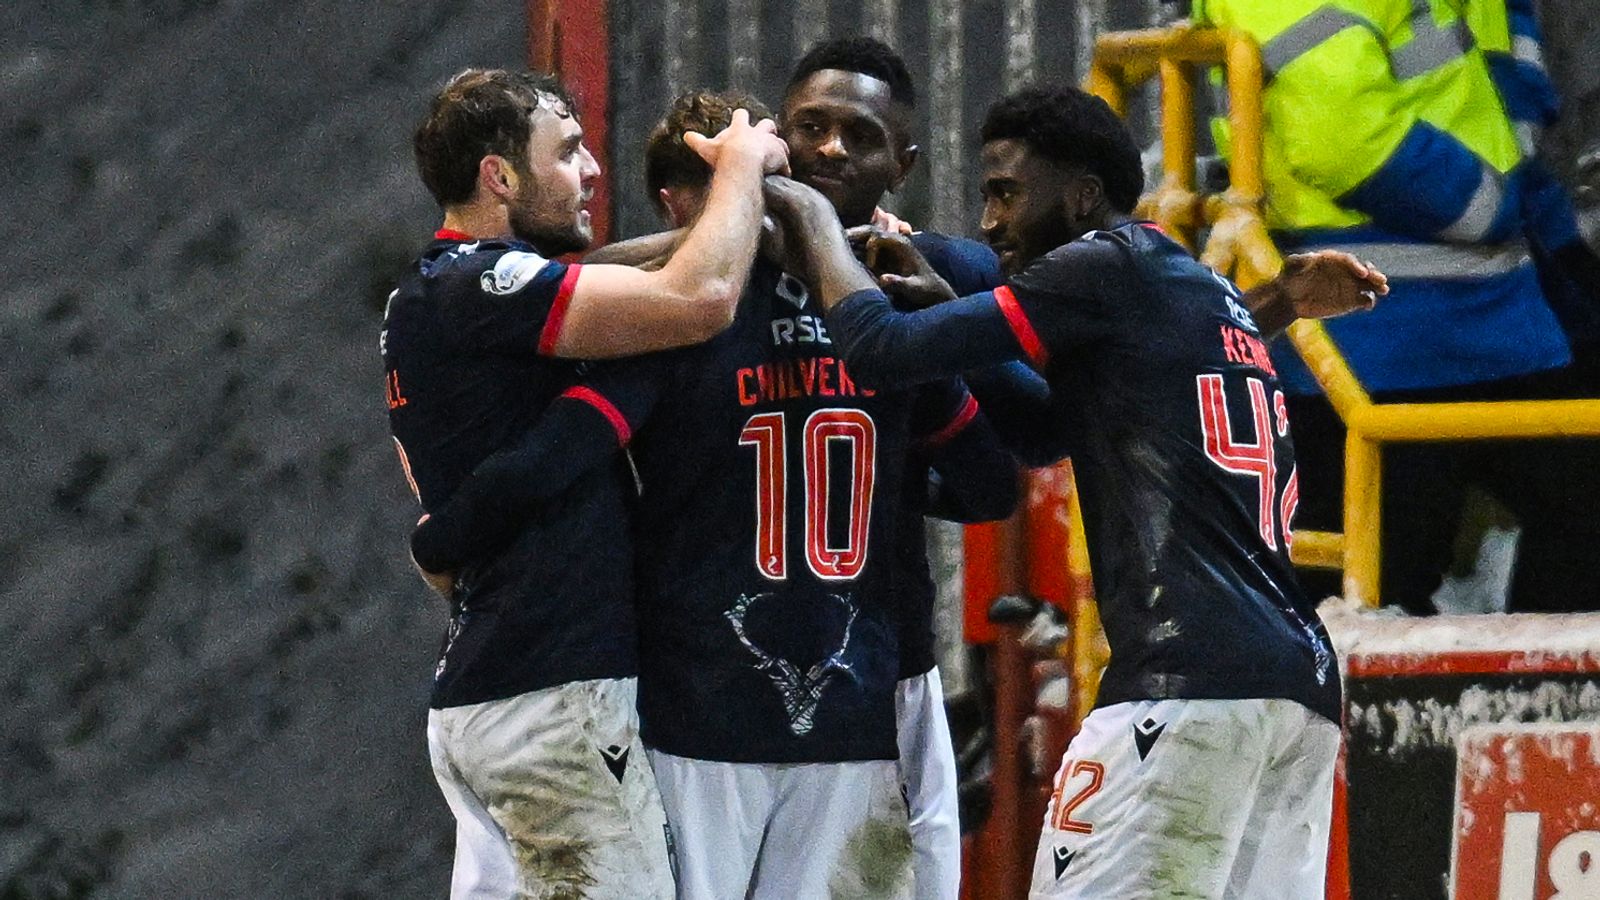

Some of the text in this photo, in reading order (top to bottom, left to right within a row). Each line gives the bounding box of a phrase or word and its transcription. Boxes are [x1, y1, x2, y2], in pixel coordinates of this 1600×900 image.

[770, 315, 832, 346] RSE
[736, 357, 876, 406] CHILVER
[738, 407, 876, 580] 10
